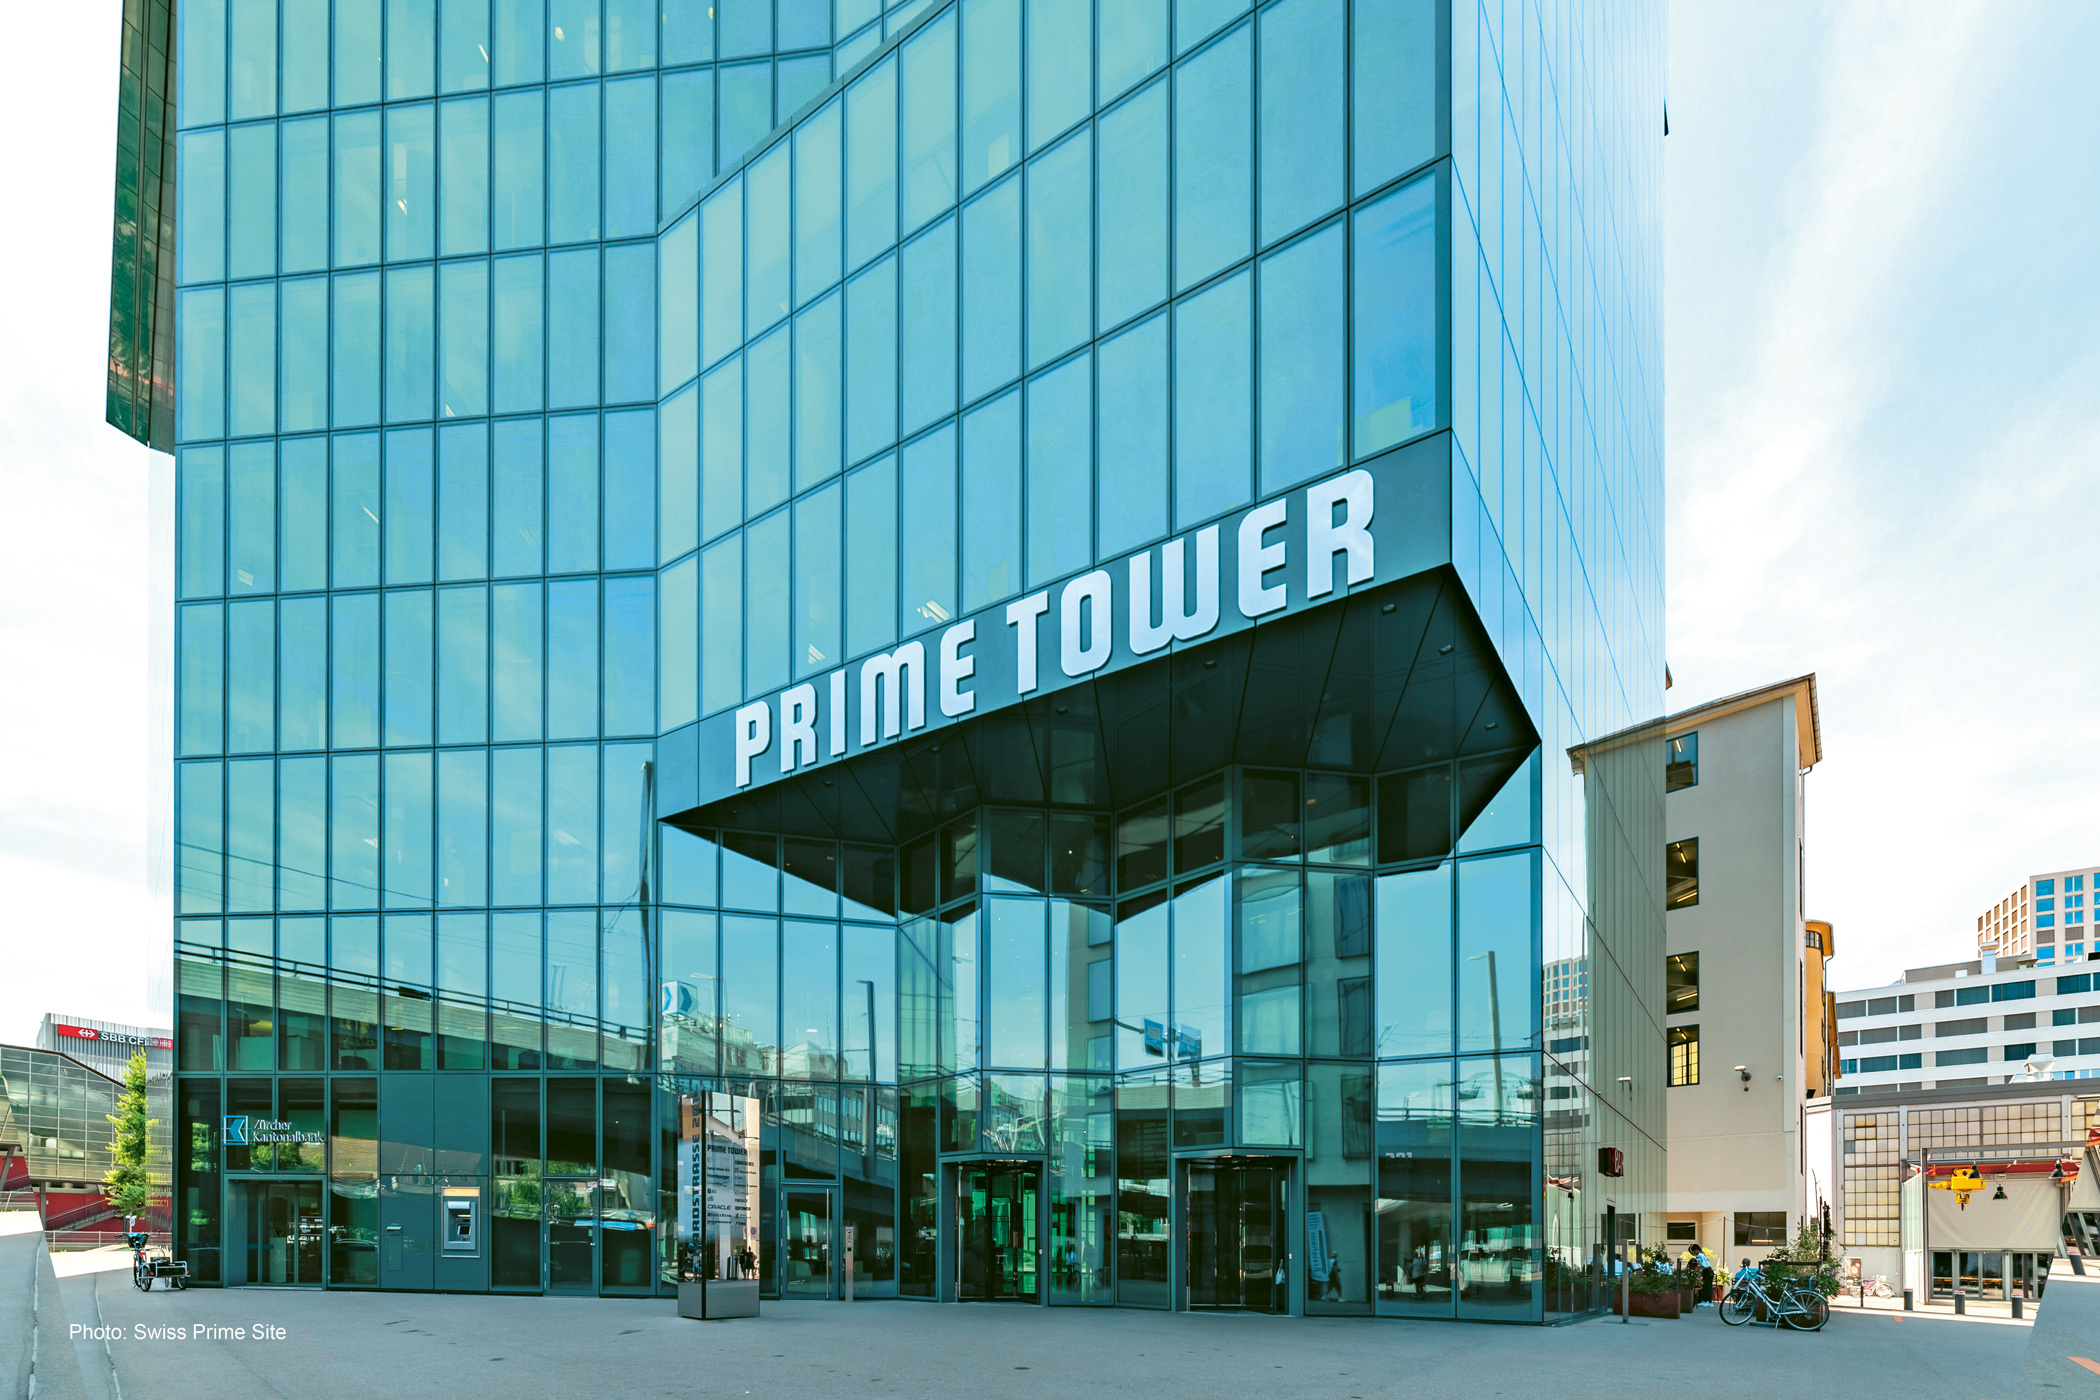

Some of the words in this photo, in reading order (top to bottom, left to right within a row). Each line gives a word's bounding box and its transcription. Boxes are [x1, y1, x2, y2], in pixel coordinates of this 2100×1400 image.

[735, 619, 977, 788] PRIME
[1006, 468, 1376, 696] TOWER
[100, 1032, 126, 1043] SBB
[128, 1036, 149, 1047] CF
[253, 1119, 292, 1130] Zürcher
[253, 1130, 324, 1143] Kantonalbank
[707, 1145, 727, 1154] PRIME
[728, 1146, 748, 1156] TOWER
